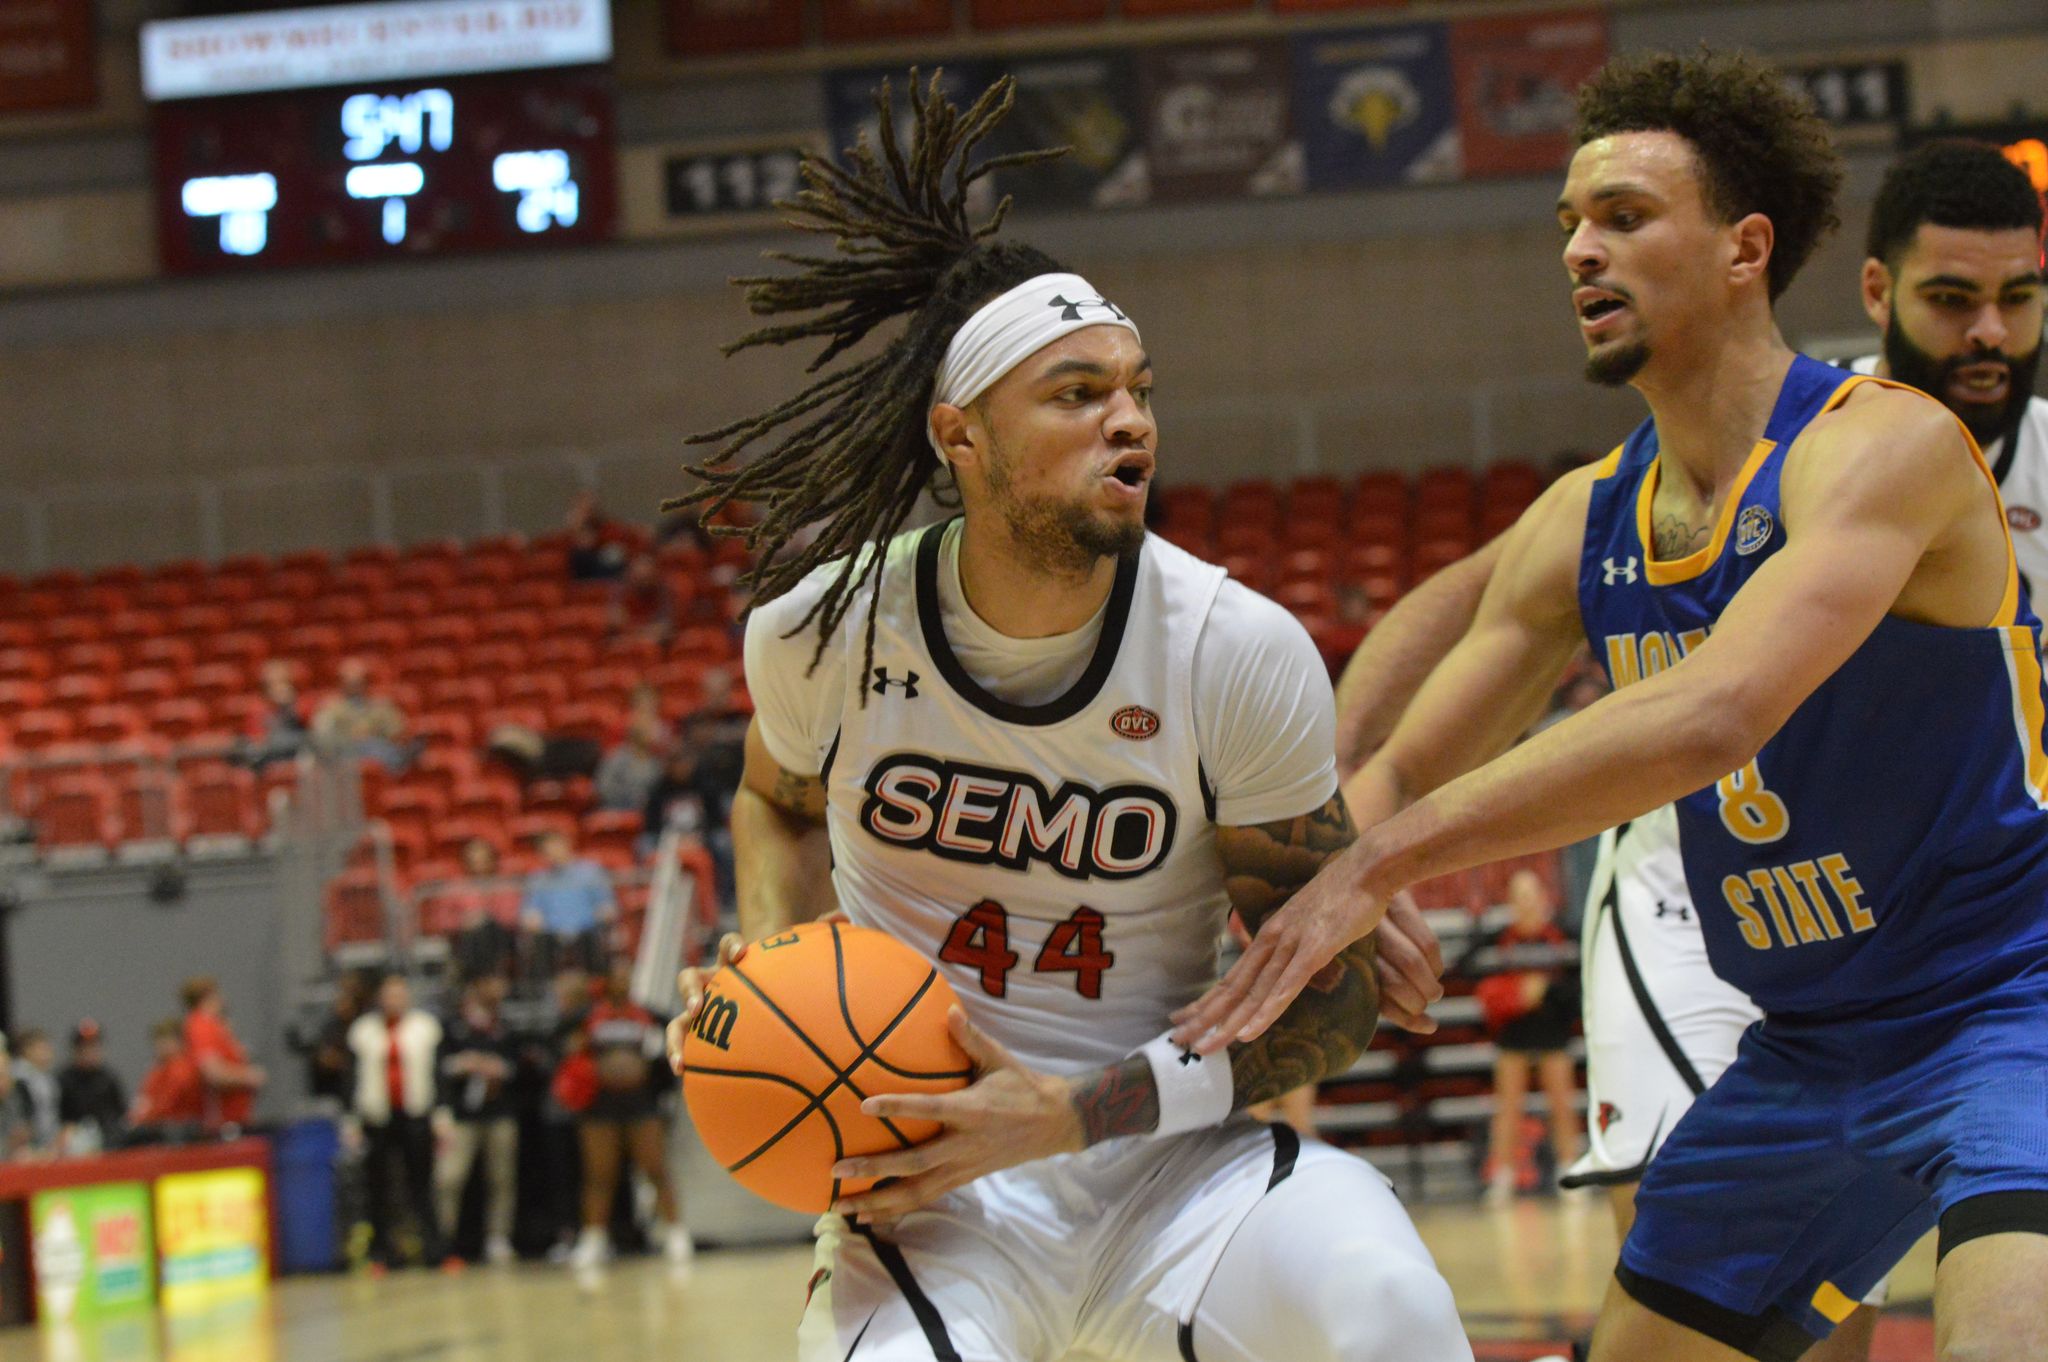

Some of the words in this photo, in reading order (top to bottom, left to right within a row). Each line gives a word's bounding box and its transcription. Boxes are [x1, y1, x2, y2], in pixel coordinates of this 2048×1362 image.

[1120, 716, 1149, 731] OVC
[865, 756, 1173, 877] SEMO
[1716, 757, 1790, 844] 8
[938, 898, 1114, 999] 44
[1721, 852, 1877, 950] STATE
